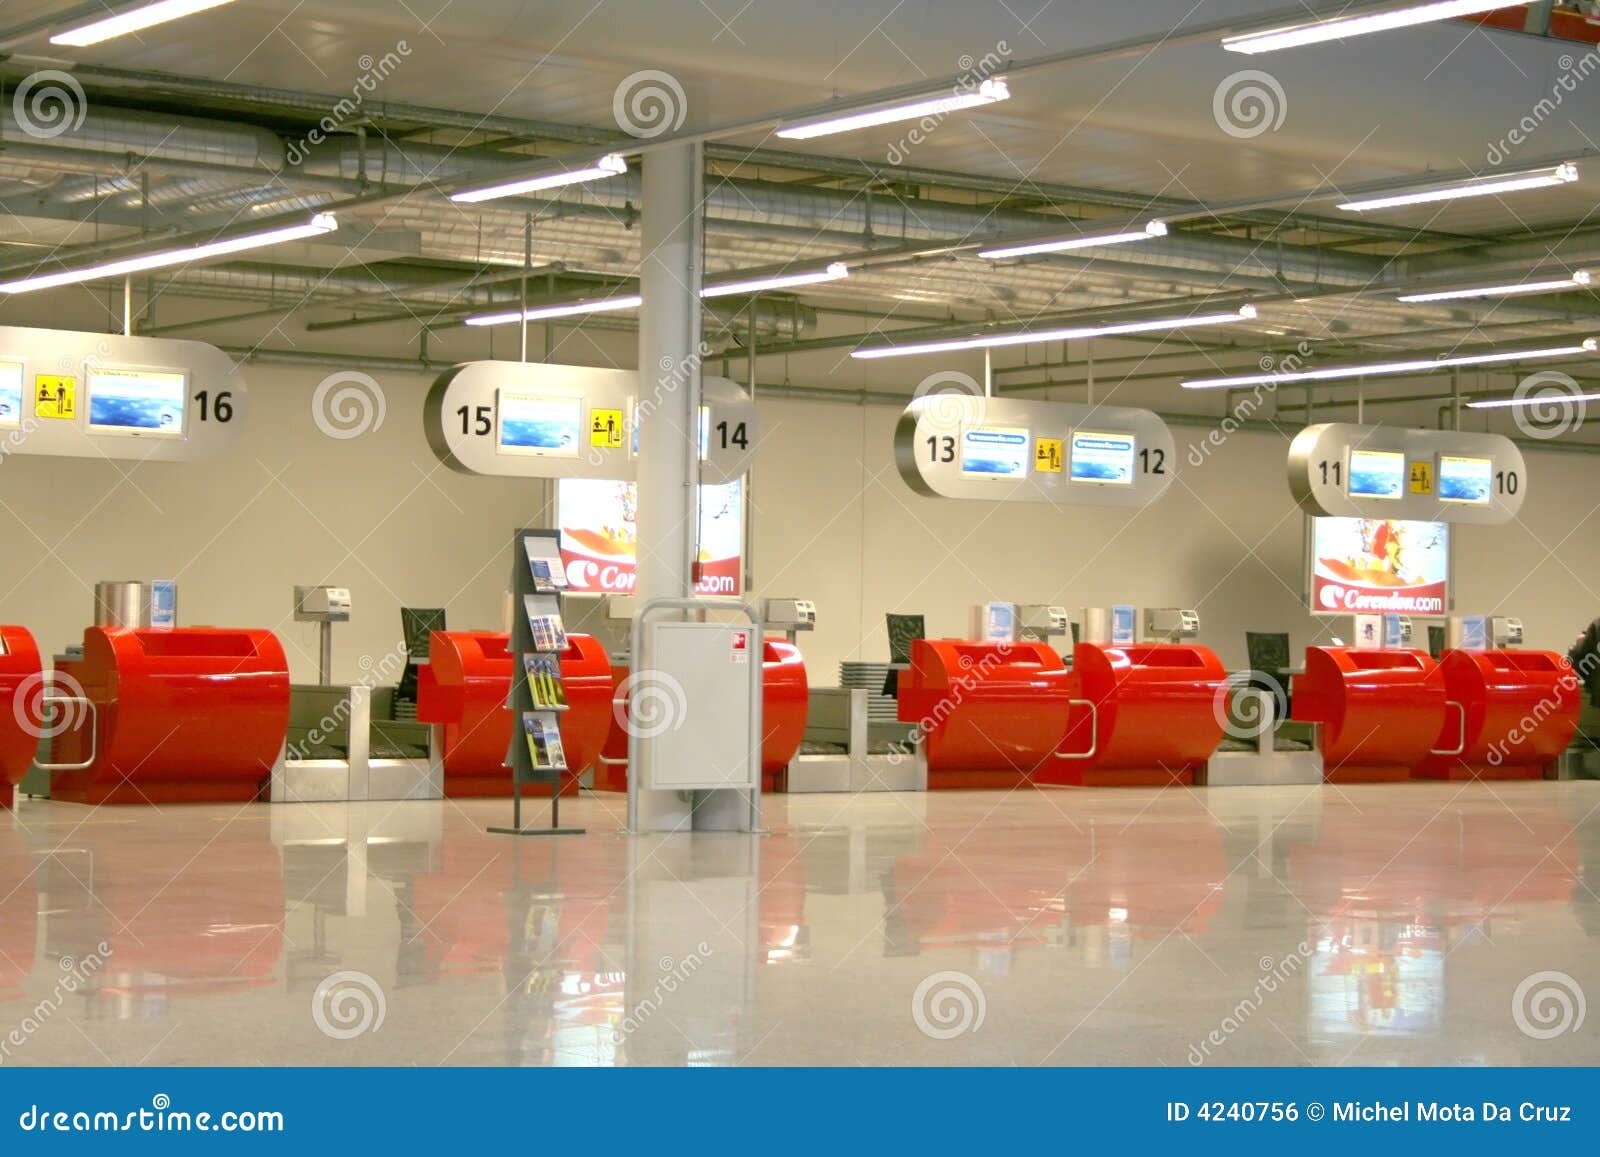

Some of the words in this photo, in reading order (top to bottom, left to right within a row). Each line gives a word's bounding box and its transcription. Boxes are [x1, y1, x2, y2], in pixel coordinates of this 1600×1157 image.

[194, 390, 233, 423] 16
[456, 405, 492, 436] 15
[716, 421, 748, 450] 14
[927, 435, 956, 463] 13
[1139, 448, 1165, 475] 12
[1319, 460, 1341, 486] 11
[1495, 471, 1518, 495] 10
